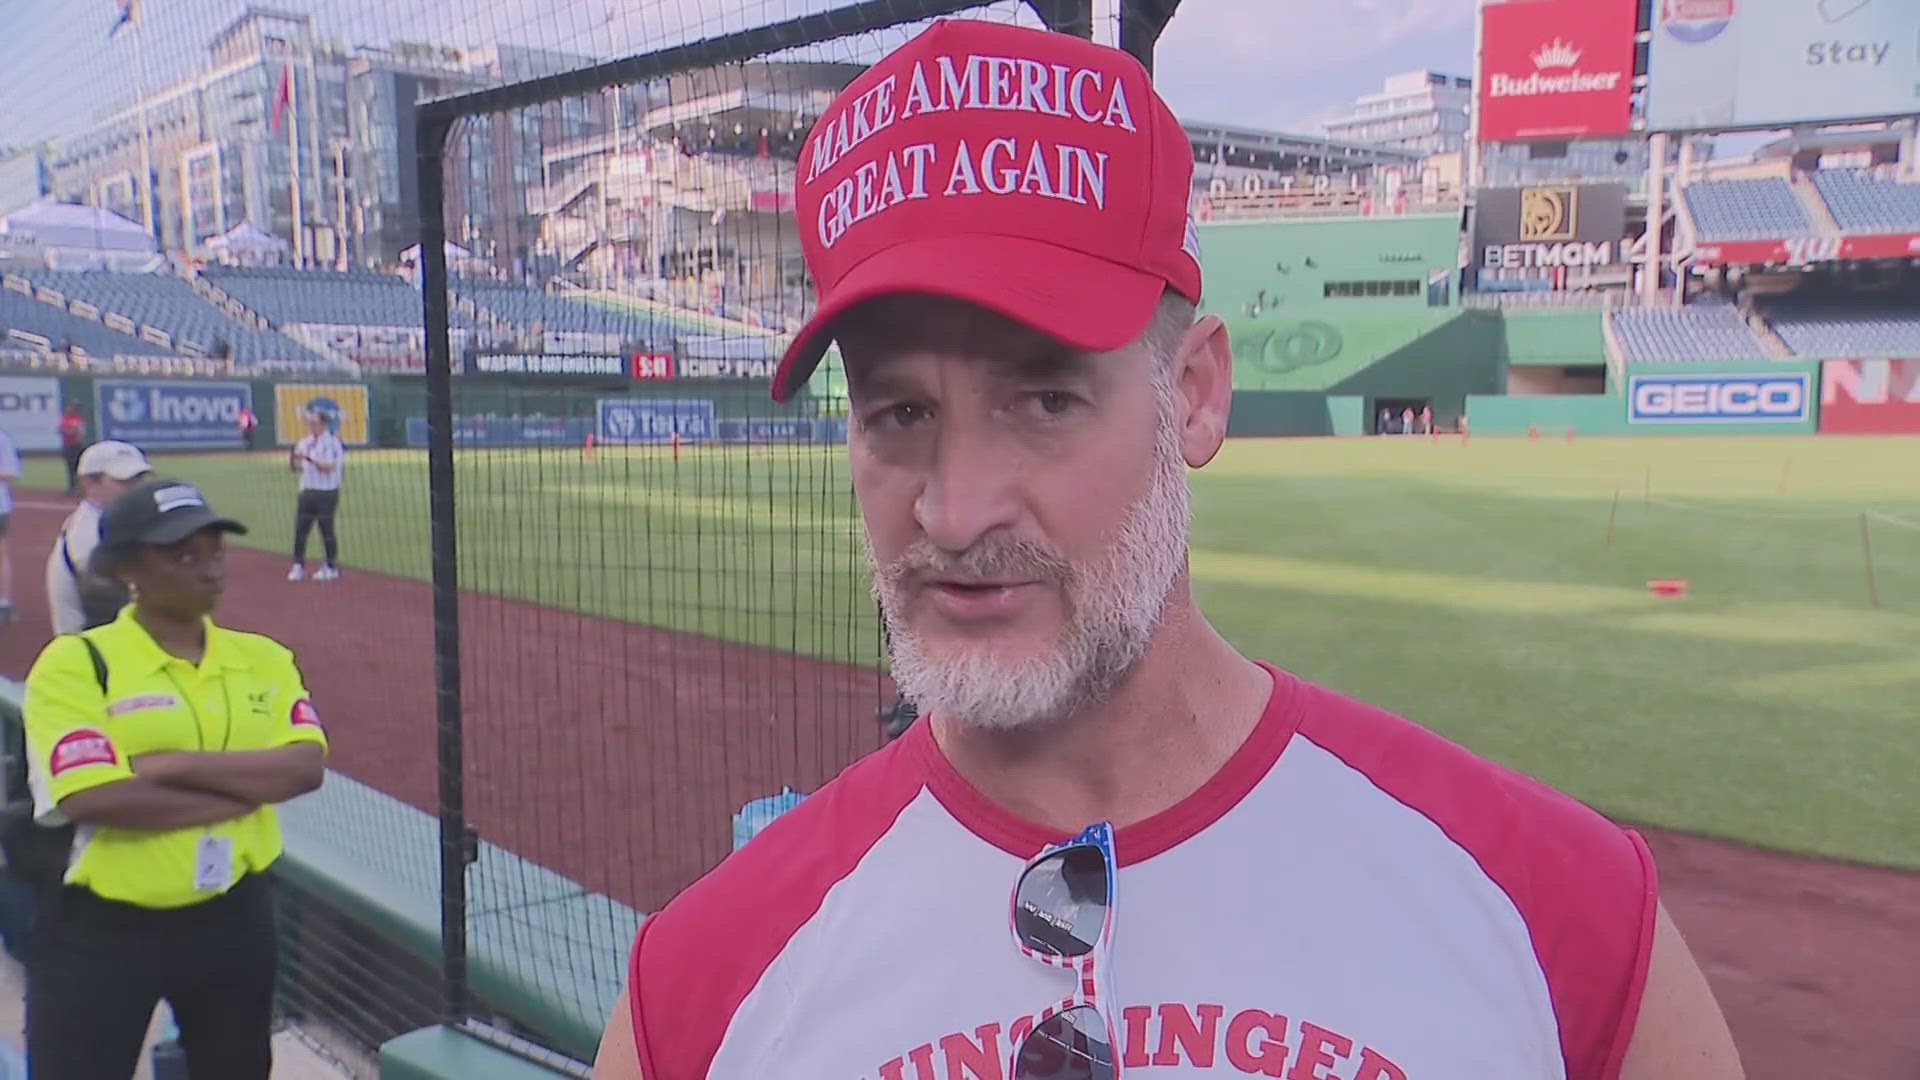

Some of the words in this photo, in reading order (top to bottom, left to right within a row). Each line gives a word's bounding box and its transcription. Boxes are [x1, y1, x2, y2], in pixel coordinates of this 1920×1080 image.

[1805, 39, 1889, 66] Stay
[1489, 71, 1621, 98] Budweiser
[804, 74, 896, 185] MAKE
[901, 54, 1137, 134] AMERICA
[817, 142, 936, 249] GREAT
[943, 137, 1109, 211] AGAIN
[1484, 240, 1612, 268] BETMGM
[152, 388, 239, 422] Inova
[1636, 382, 1803, 414] GEICO
